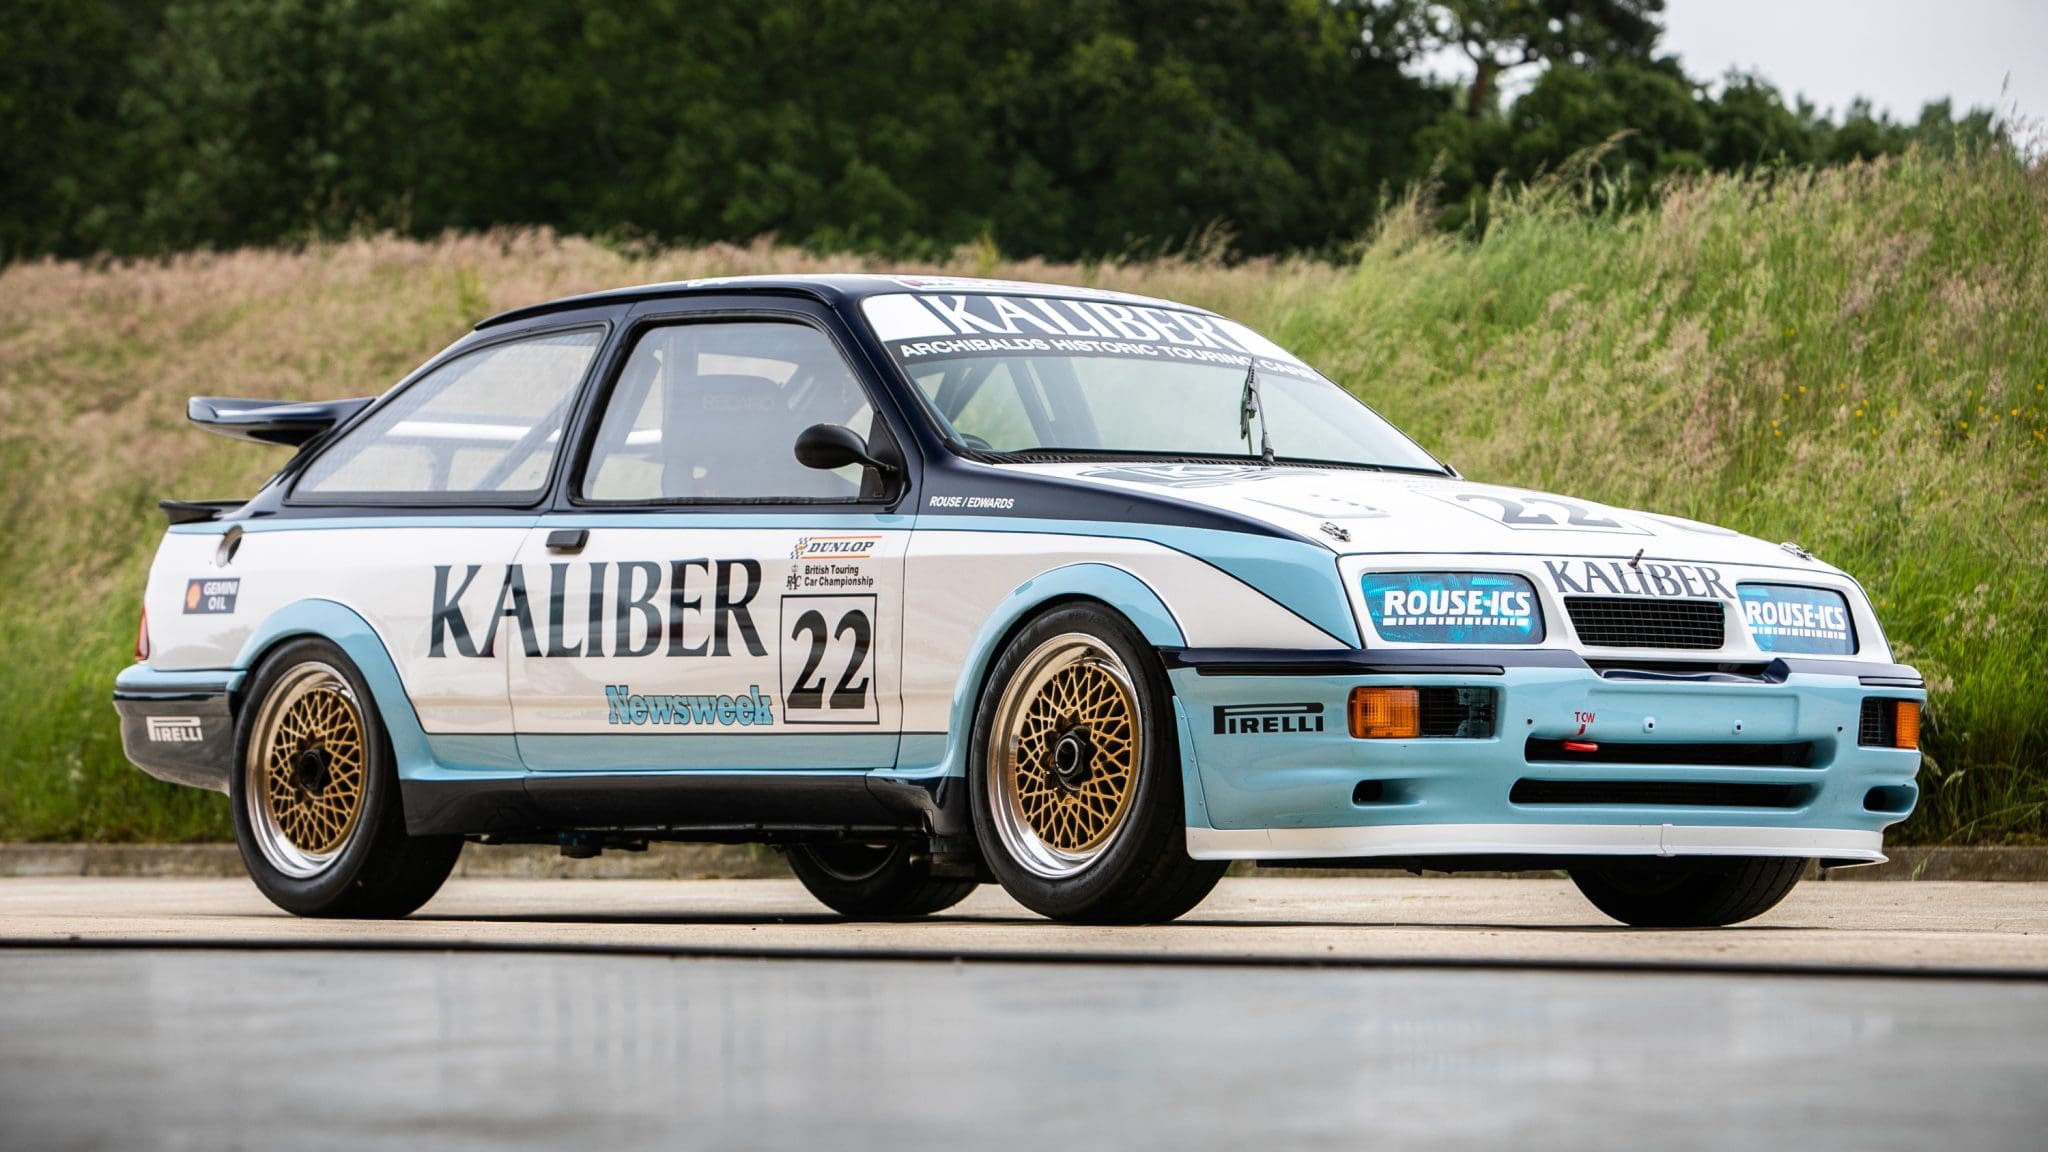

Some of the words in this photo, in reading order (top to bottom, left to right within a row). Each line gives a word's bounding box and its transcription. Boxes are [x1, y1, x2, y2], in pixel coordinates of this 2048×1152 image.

[918, 295, 1249, 351] KALIBER
[900, 337, 1050, 358] ARCHIBALDS
[1049, 339, 1159, 357] HISTORIC
[929, 496, 962, 507] ROUSE
[967, 497, 1015, 509] EDWARDS
[1455, 494, 1622, 528] 22
[808, 541, 874, 552] DUNLOP
[804, 576, 818, 586] Car
[819, 576, 874, 588] Championship
[805, 564, 829, 575] British
[830, 564, 859, 576] Touring
[1542, 560, 1736, 599] KALIBER
[204, 582, 237, 595] GEMINI
[208, 597, 226, 610] OIL
[427, 558, 768, 657] KALIBER
[1384, 590, 1531, 617] ROUSE-ICS
[786, 609, 872, 709] 22
[605, 685, 774, 725] Newsweek
[146, 716, 203, 741] PIRELLI
[1213, 702, 1324, 735] PIRELLI
